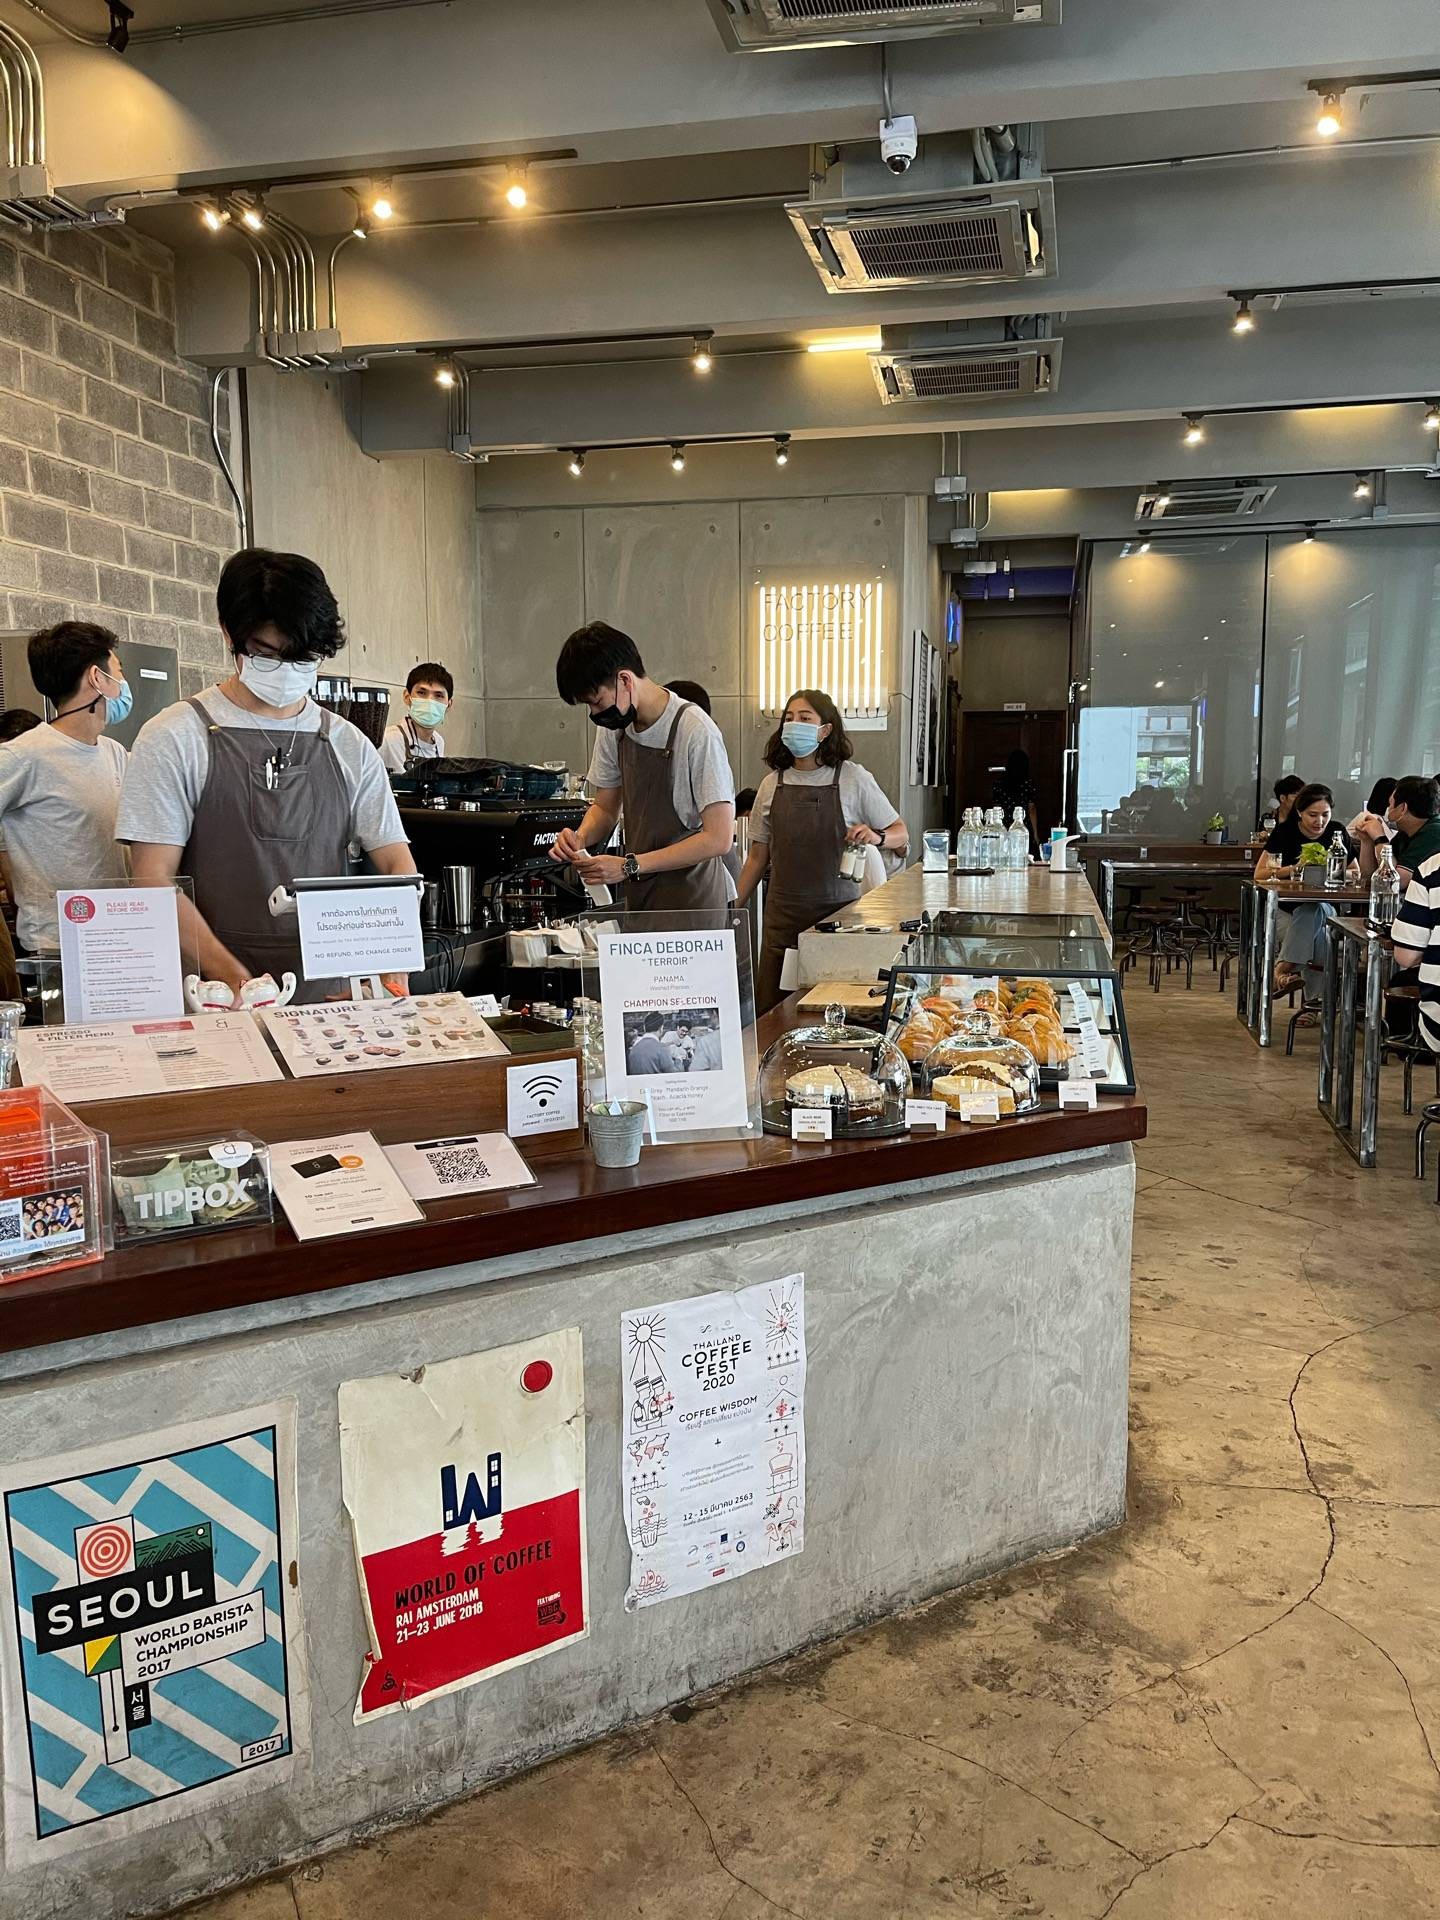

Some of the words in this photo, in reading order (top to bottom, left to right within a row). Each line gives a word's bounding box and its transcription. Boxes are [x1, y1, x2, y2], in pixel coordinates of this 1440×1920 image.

[764, 590, 873, 611] FACTORY
[763, 622, 853, 642] COFFEE
[610, 942, 653, 956] FINCA
[656, 939, 724, 954] DEBORAH
[654, 975, 685, 983] PANAMA
[273, 1005, 362, 1018] SIGNATURE
[623, 998, 668, 1008] CHAMPION
[670, 996, 717, 1006] SELECTION
[36, 1030, 91, 1038] ESPRESSO
[48, 1034, 84, 1042] FILTER
[133, 1178, 250, 1219] TIPBOX
[693, 1334, 742, 1350] THAILAND
[681, 1340, 752, 1368] COFFEE
[696, 1358, 739, 1379] FEST
[703, 1373, 735, 1392] 2020
[678, 1406, 718, 1423] COFFEE
[719, 1395, 758, 1412] WISDOM
[682, 1512, 693, 1522] 12
[699, 1509, 709, 1517] 15
[710, 1499, 734, 1513] มีนาคม
[735, 1492, 754, 1504] 2563
[394, 1572, 456, 1610] WORLD
[464, 1562, 486, 1585] OF
[493, 1540, 552, 1575] COFFEE
[47, 1570, 204, 1636] SEOUL
[396, 1610, 414, 1628] RAI
[416, 1587, 480, 1621] AMSTERDAM
[134, 1622, 190, 1647] WORLD
[192, 1602, 254, 1630] BARISTA
[433, 1611, 456, 1630] JUNE
[459, 1601, 484, 1622] 2018
[136, 1619, 248, 1662] CHAMPIONSHIP
[138, 1658, 171, 1678] 2017
[249, 1740, 276, 1756] 2017
